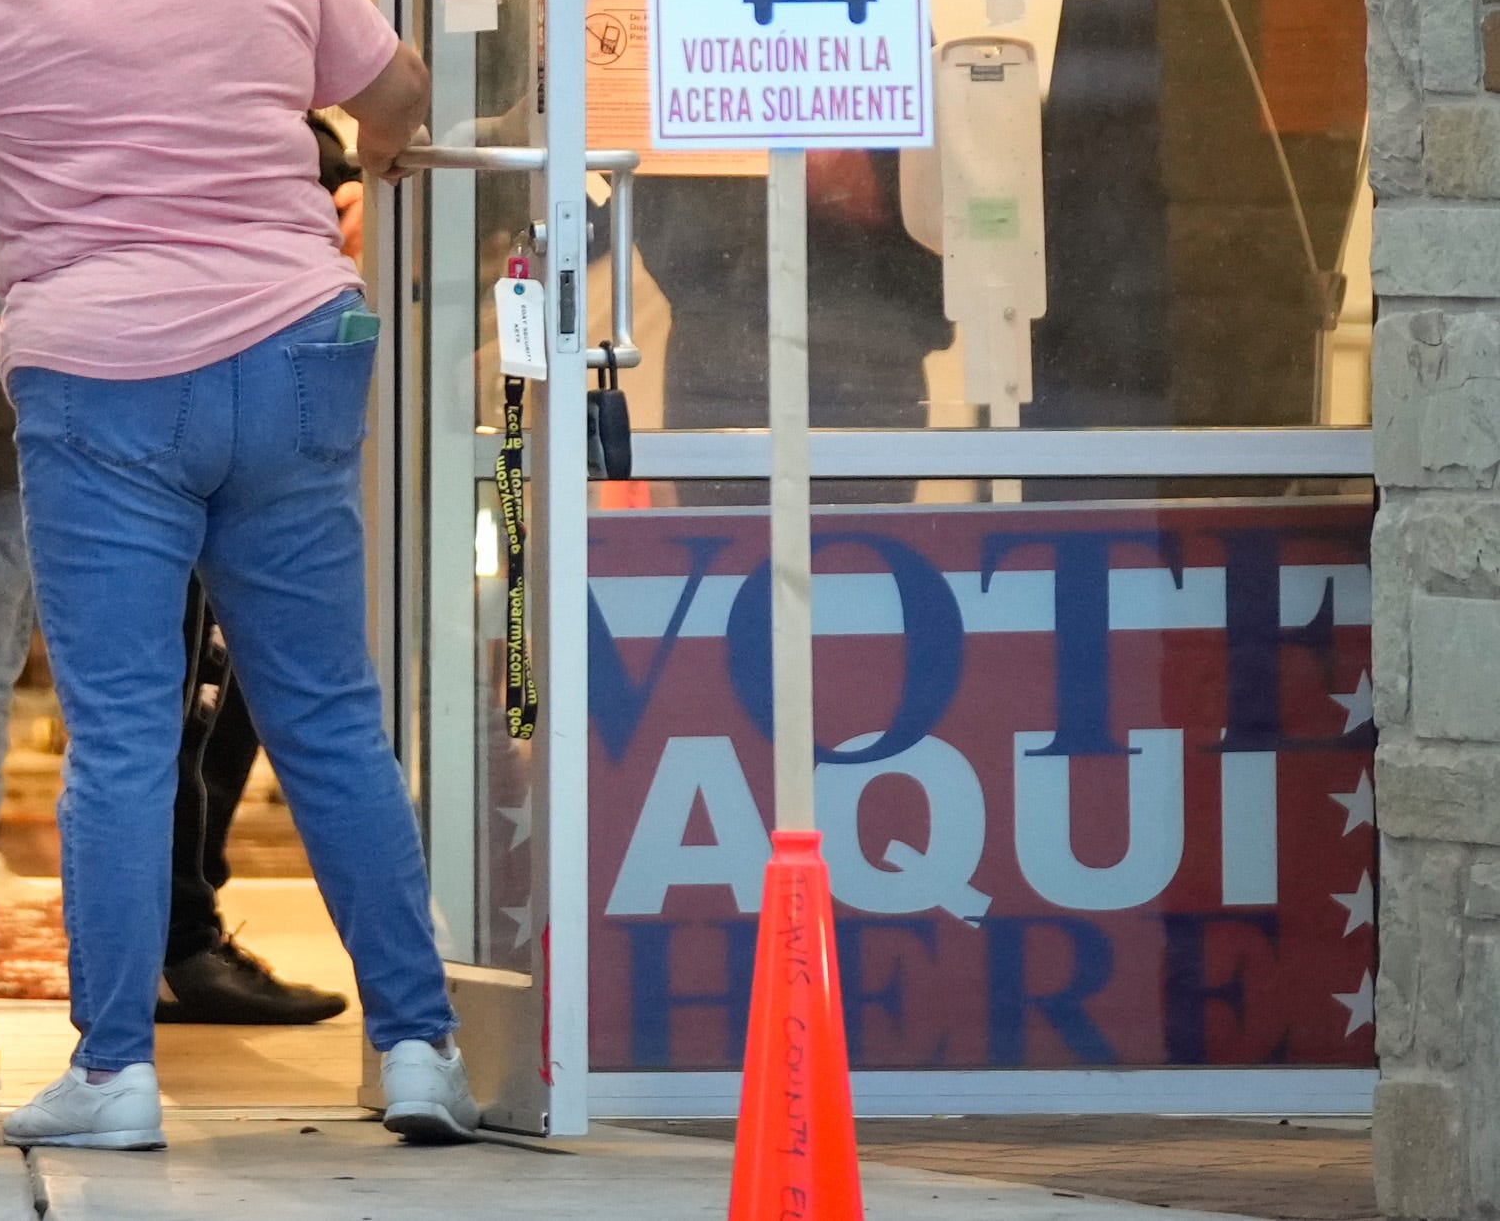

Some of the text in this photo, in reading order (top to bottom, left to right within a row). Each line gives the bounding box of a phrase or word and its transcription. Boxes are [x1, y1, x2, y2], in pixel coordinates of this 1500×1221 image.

[682, 29, 813, 74] VOTACIÓN
[820, 37, 849, 72] EN
[861, 36, 891, 72] LA
[668, 87, 752, 124] ACERA
[763, 85, 914, 122] SOLAMENTE
[508, 585, 524, 688] goarmy.com
[588, 527, 1376, 765] VOTE
[604, 727, 1277, 927] AQUI
